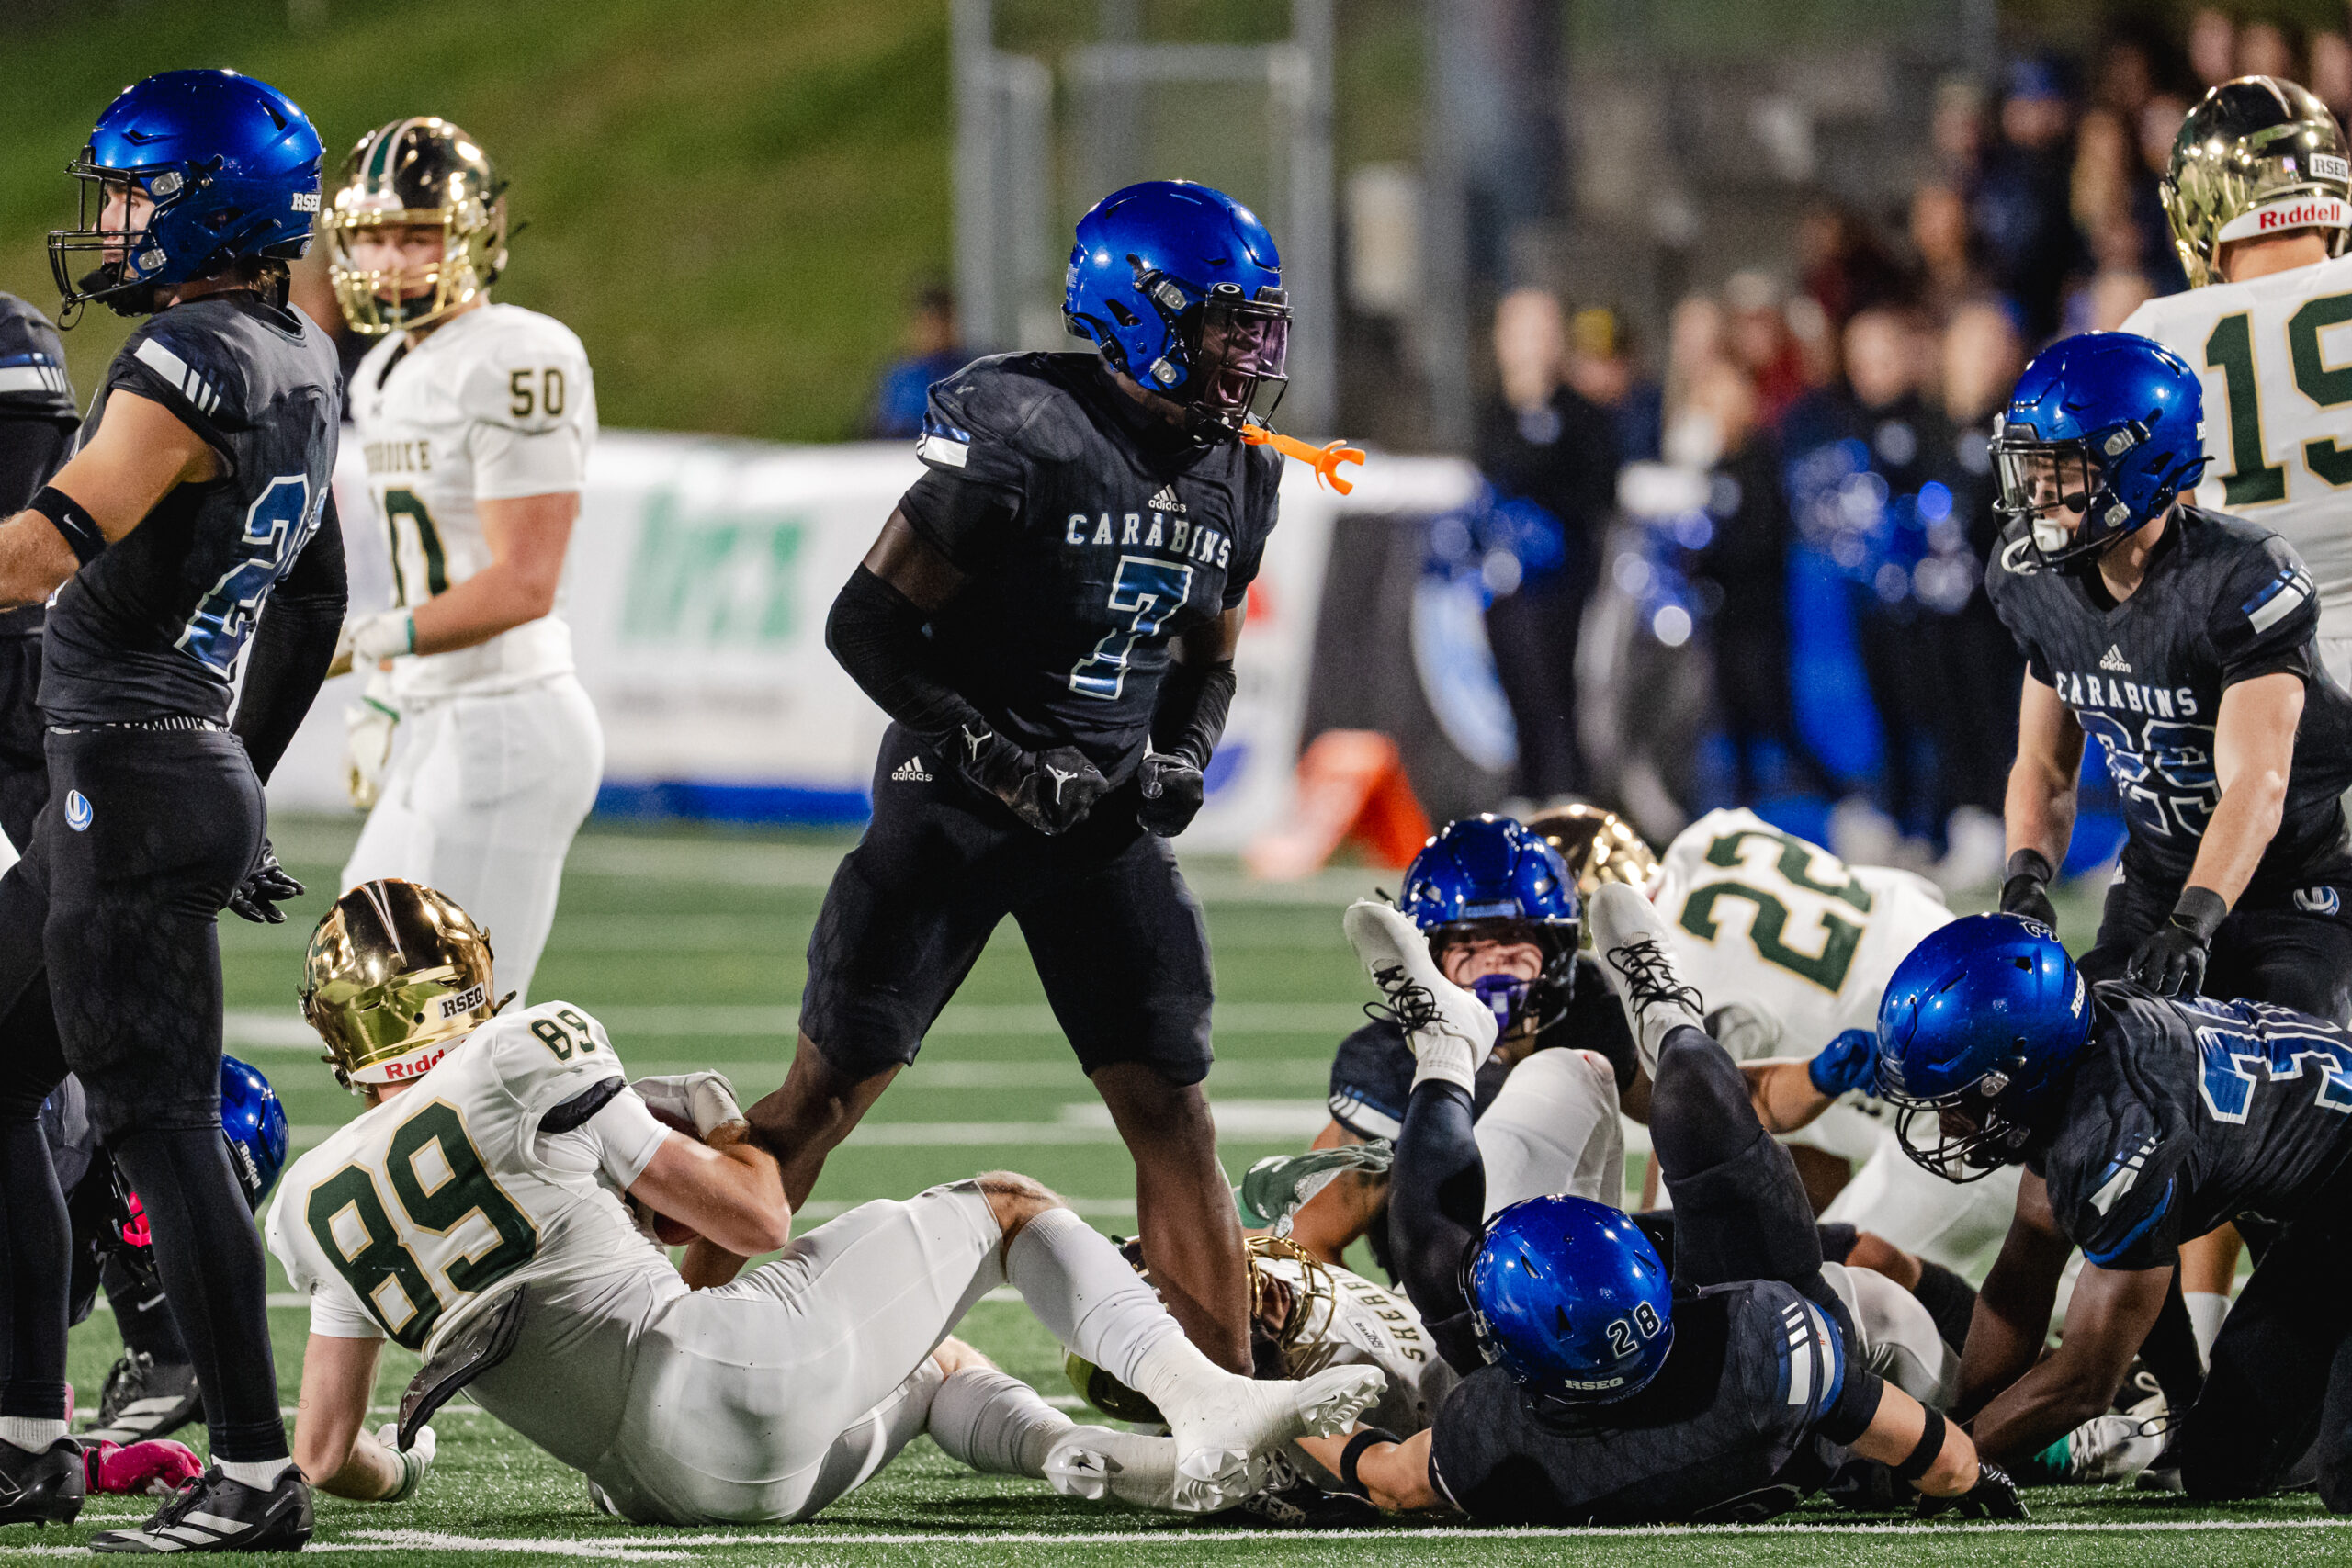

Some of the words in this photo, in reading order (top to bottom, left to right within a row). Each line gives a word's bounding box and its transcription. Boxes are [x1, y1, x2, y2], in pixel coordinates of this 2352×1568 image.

[2259, 203, 2341, 230] Riddell
[509, 368, 565, 419] 50
[1148, 498, 1187, 513] adidas
[1066, 513, 1232, 569] CARABINS
[173, 472, 329, 681] 2
[1068, 555, 1194, 700] 7
[2099, 659, 2132, 673] adidas
[2055, 671, 2198, 718] CARABINS
[891, 770, 933, 782] adidas
[1675, 829, 1875, 998] 22
[440, 986, 486, 1020] RSEQ
[527, 1009, 597, 1066] 89
[384, 1047, 447, 1080] Ridd
[239, 1144, 263, 1190] Riddell
[303, 1095, 541, 1352] 89
[1606, 1300, 1662, 1359] 28
[1564, 1376, 1624, 1391] RSEQ
